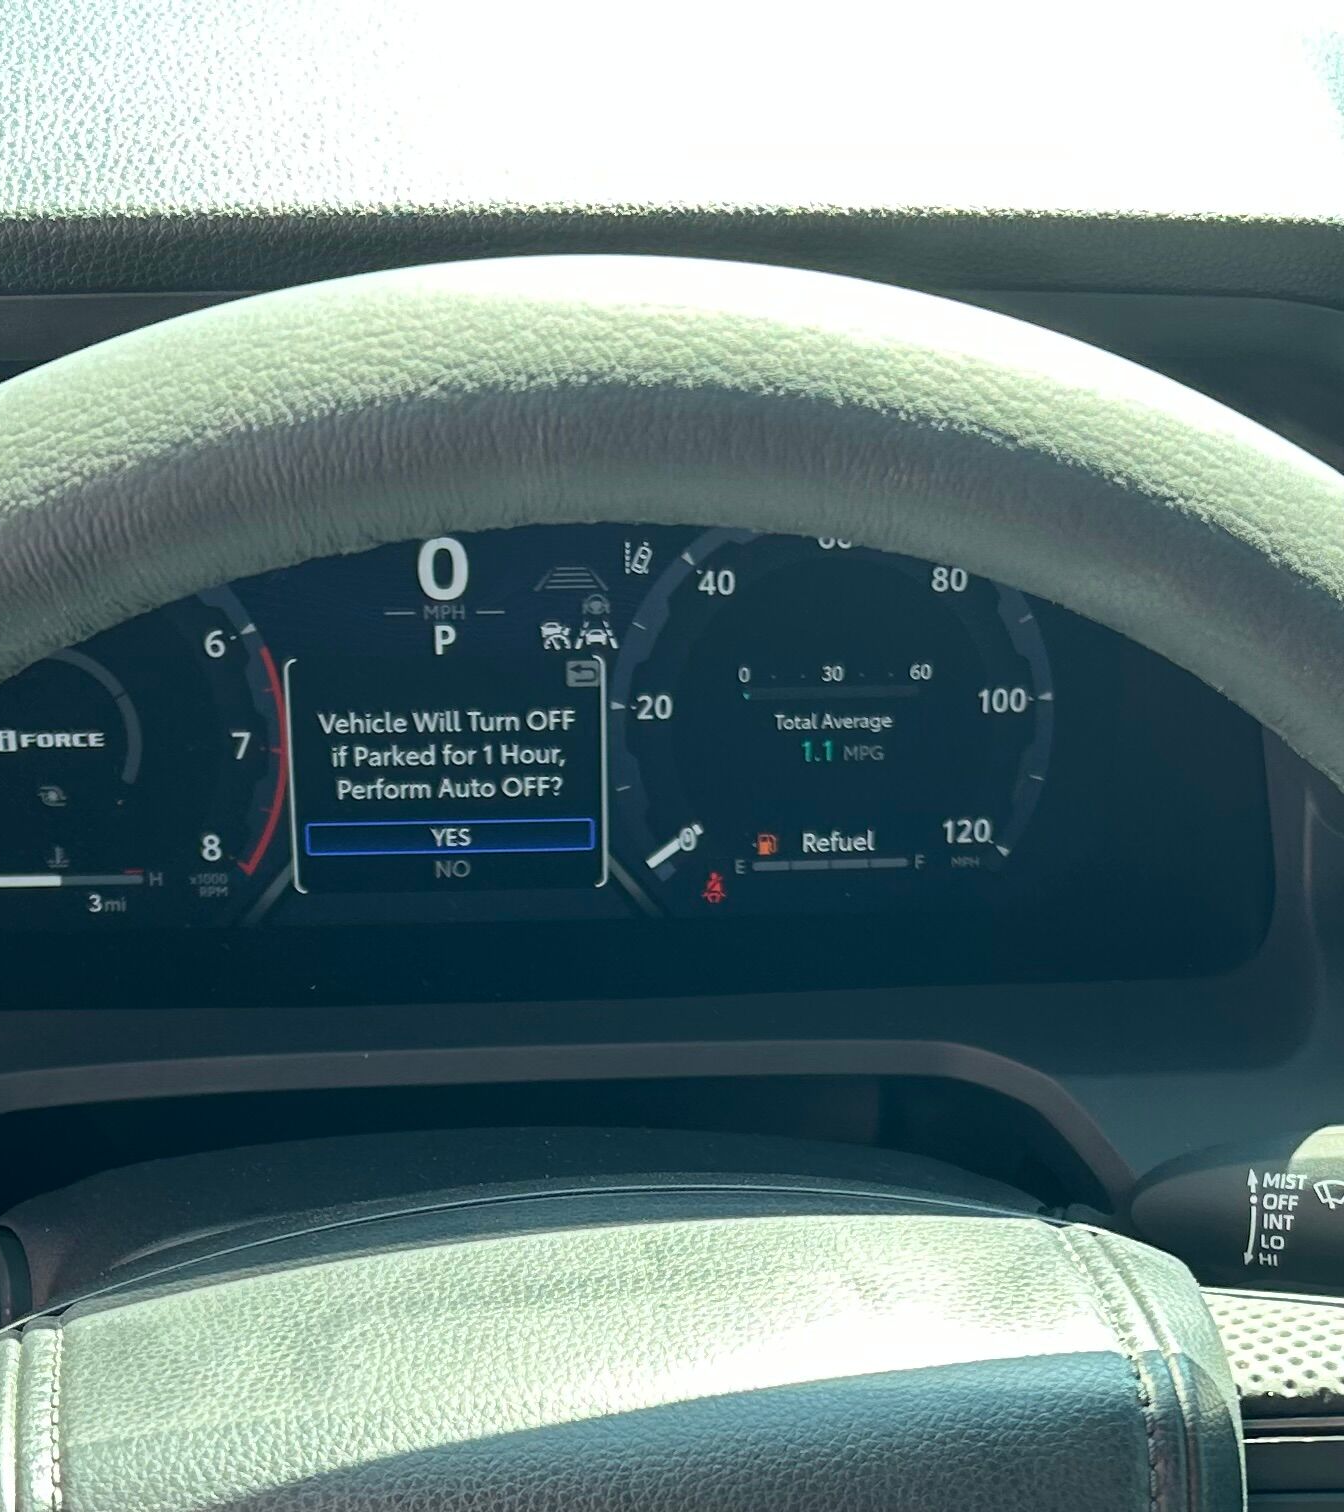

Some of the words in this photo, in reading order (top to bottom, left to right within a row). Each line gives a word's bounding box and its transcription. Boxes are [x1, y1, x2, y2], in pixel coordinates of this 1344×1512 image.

[418, 537, 468, 601] 0
[932, 567, 967, 592] 80
[698, 570, 736, 596] 40
[424, 605, 465, 620] MPH
[204, 631, 226, 658] 6
[434, 625, 456, 656] P
[738, 666, 752, 683] 0
[821, 665, 845, 682] 30
[909, 663, 933, 681] 60
[636, 695, 673, 721] 20
[978, 687, 1027, 714] 100
[317, 711, 407, 735] Vehicle
[412, 710, 462, 733] Will
[467, 710, 520, 732] Turn
[526, 709, 576, 732] OFF
[774, 712, 818, 731] Total
[821, 712, 894, 733] Average
[231, 731, 251, 760] 7
[332, 745, 349, 767] if
[354, 744, 436, 767] Parked
[442, 743, 477, 766] for
[482, 744, 493, 765] 1
[501, 743, 567, 769] Hour,
[801, 739, 834, 763] 1.1
[843, 745, 885, 761] MPG
[336, 778, 431, 801] Perform
[438, 777, 496, 800] Auto
[501, 776, 564, 798] OFF?
[429, 827, 472, 848] YES
[802, 830, 876, 854] Refuel
[942, 817, 991, 844] 120
[201, 834, 223, 861] 8
[434, 860, 472, 879] NO
[734, 859, 746, 875] E
[913, 854, 926, 870] F
[149, 873, 164, 887] H
[88, 893, 103, 913] 3
[106, 897, 127, 912] mi
[1262, 1172, 1307, 1191] MIST
[1262, 1194, 1299, 1211] OFF
[1263, 1213, 1294, 1231] INT
[1260, 1233, 1285, 1250] LO
[1258, 1251, 1279, 1267] HI
